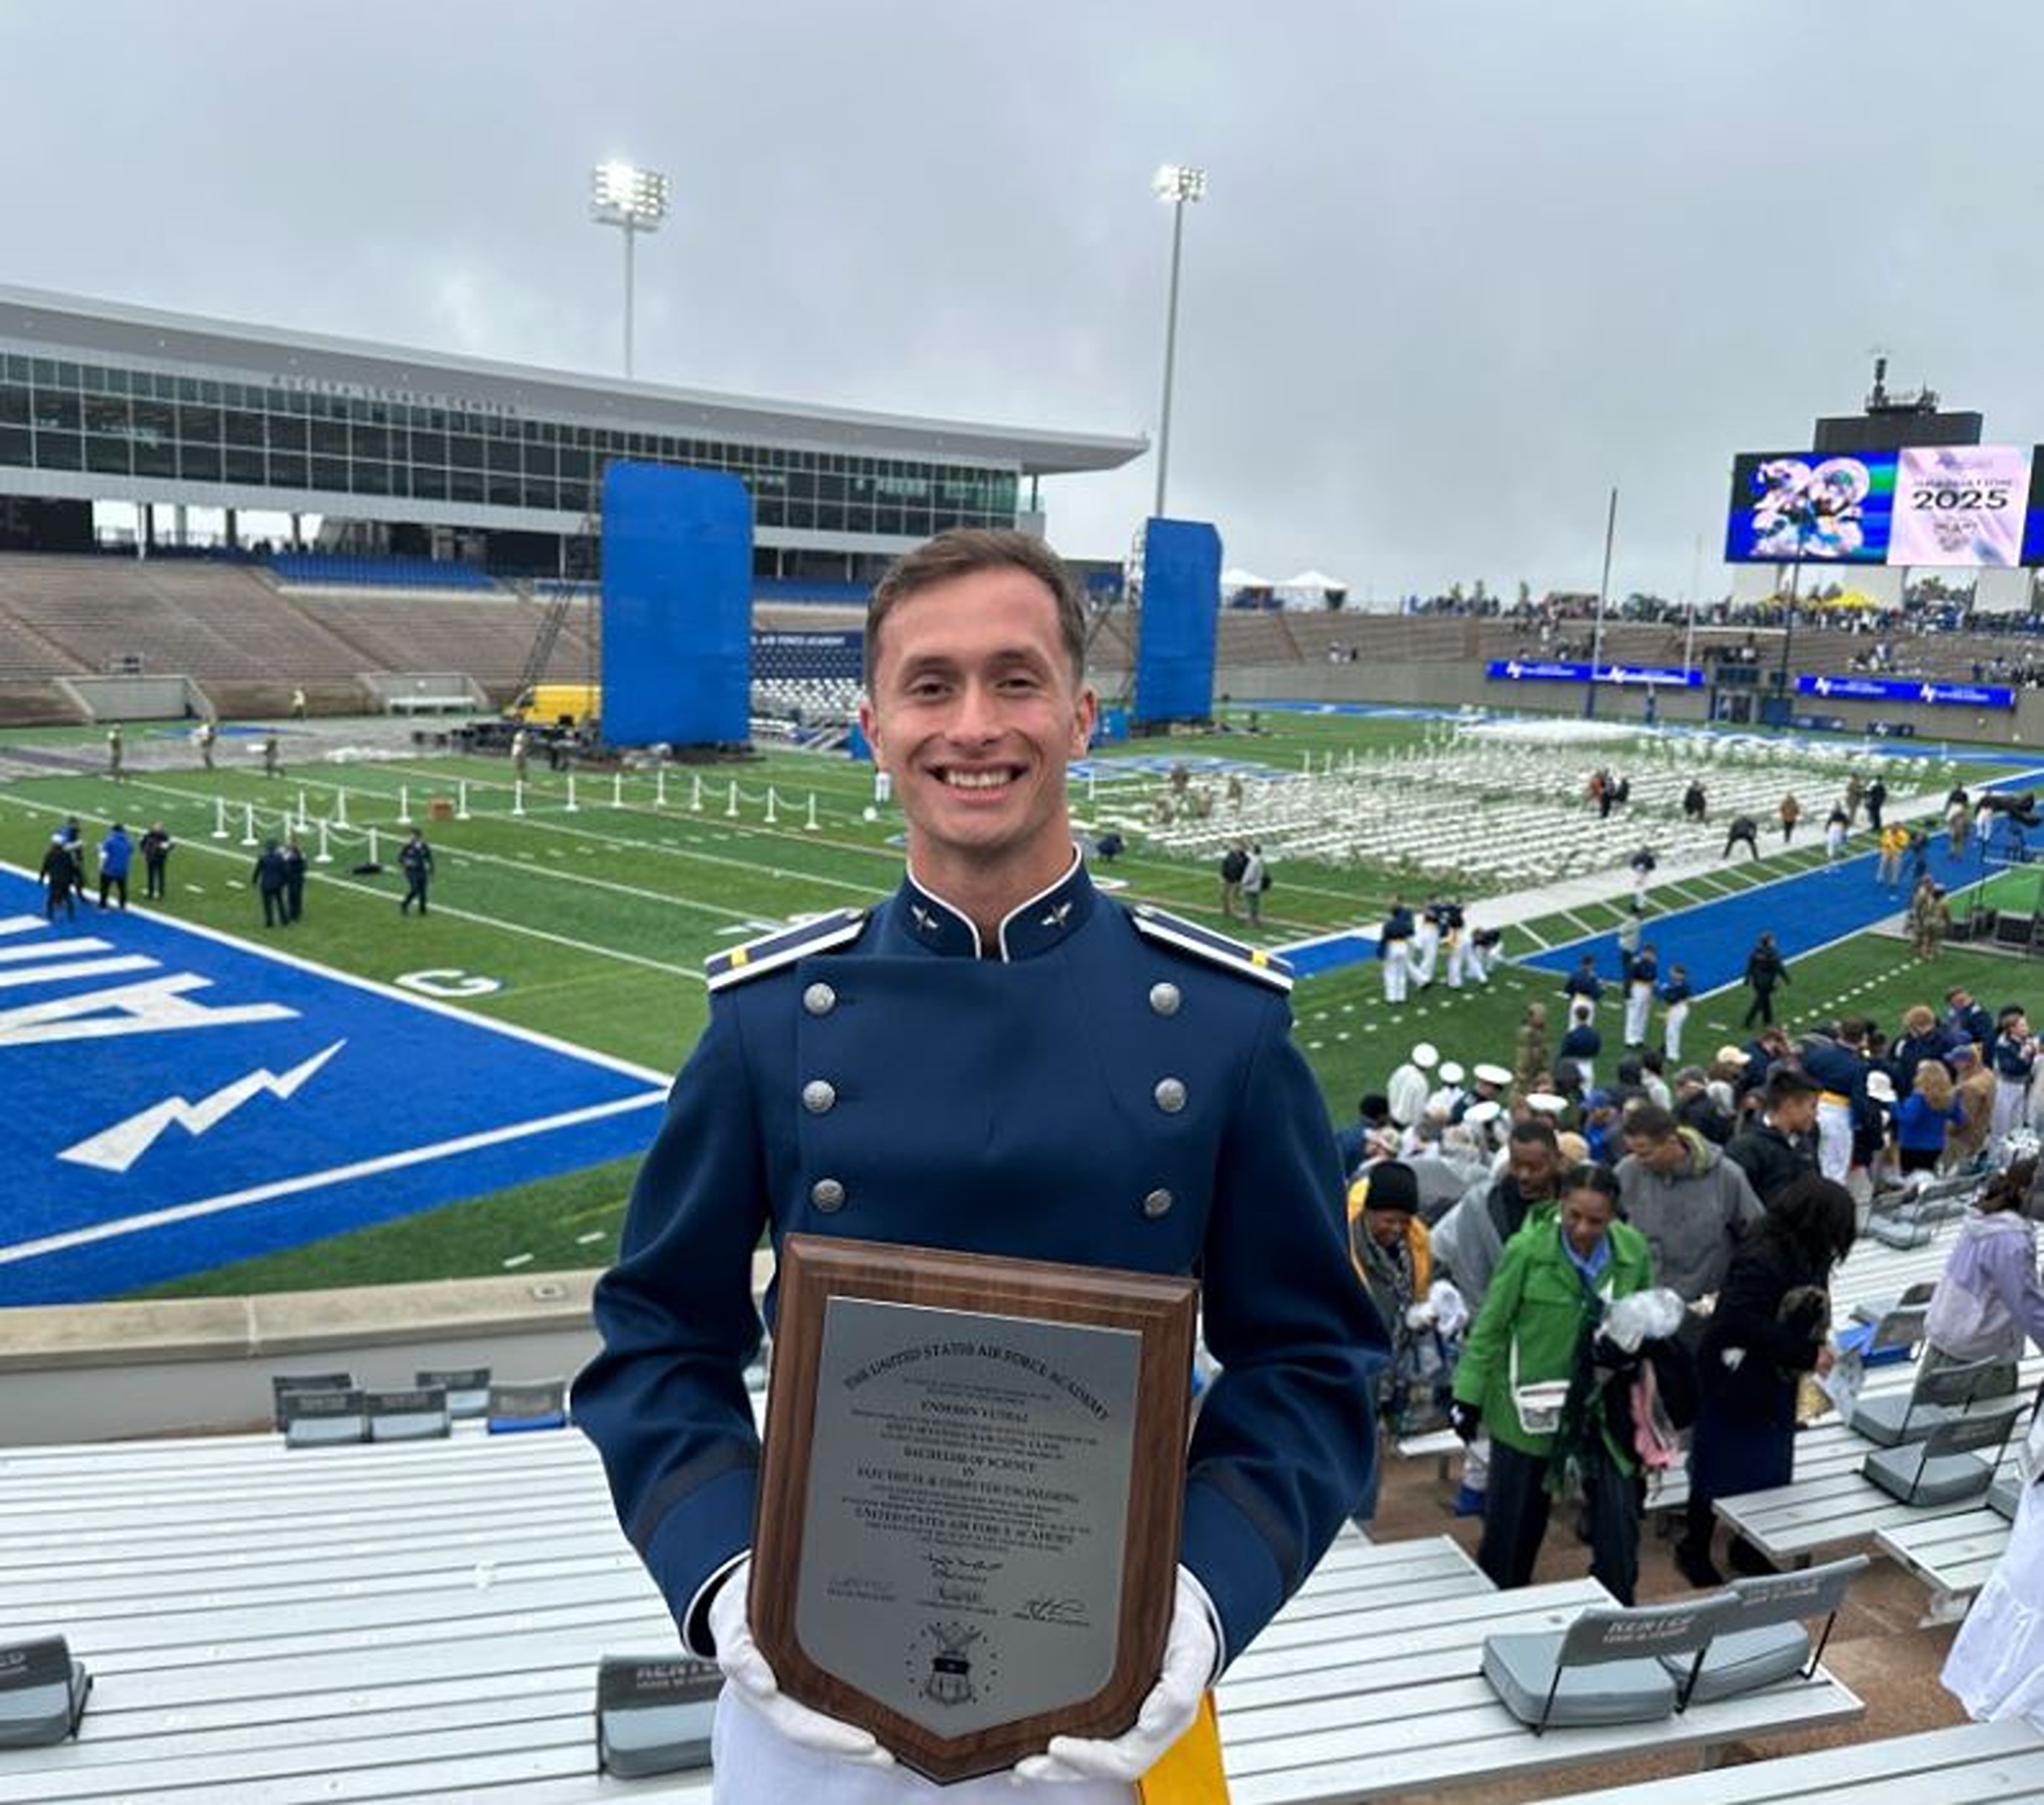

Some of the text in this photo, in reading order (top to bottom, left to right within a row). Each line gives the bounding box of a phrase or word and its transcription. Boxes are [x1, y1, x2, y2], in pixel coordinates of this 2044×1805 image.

[1912, 489, 2009, 511] 2025
[870, 1348, 923, 1375] UNITED
[924, 1342, 973, 1359] STATES
[978, 1342, 1001, 1358] AIR
[1003, 1349, 1048, 1379] FORCE
